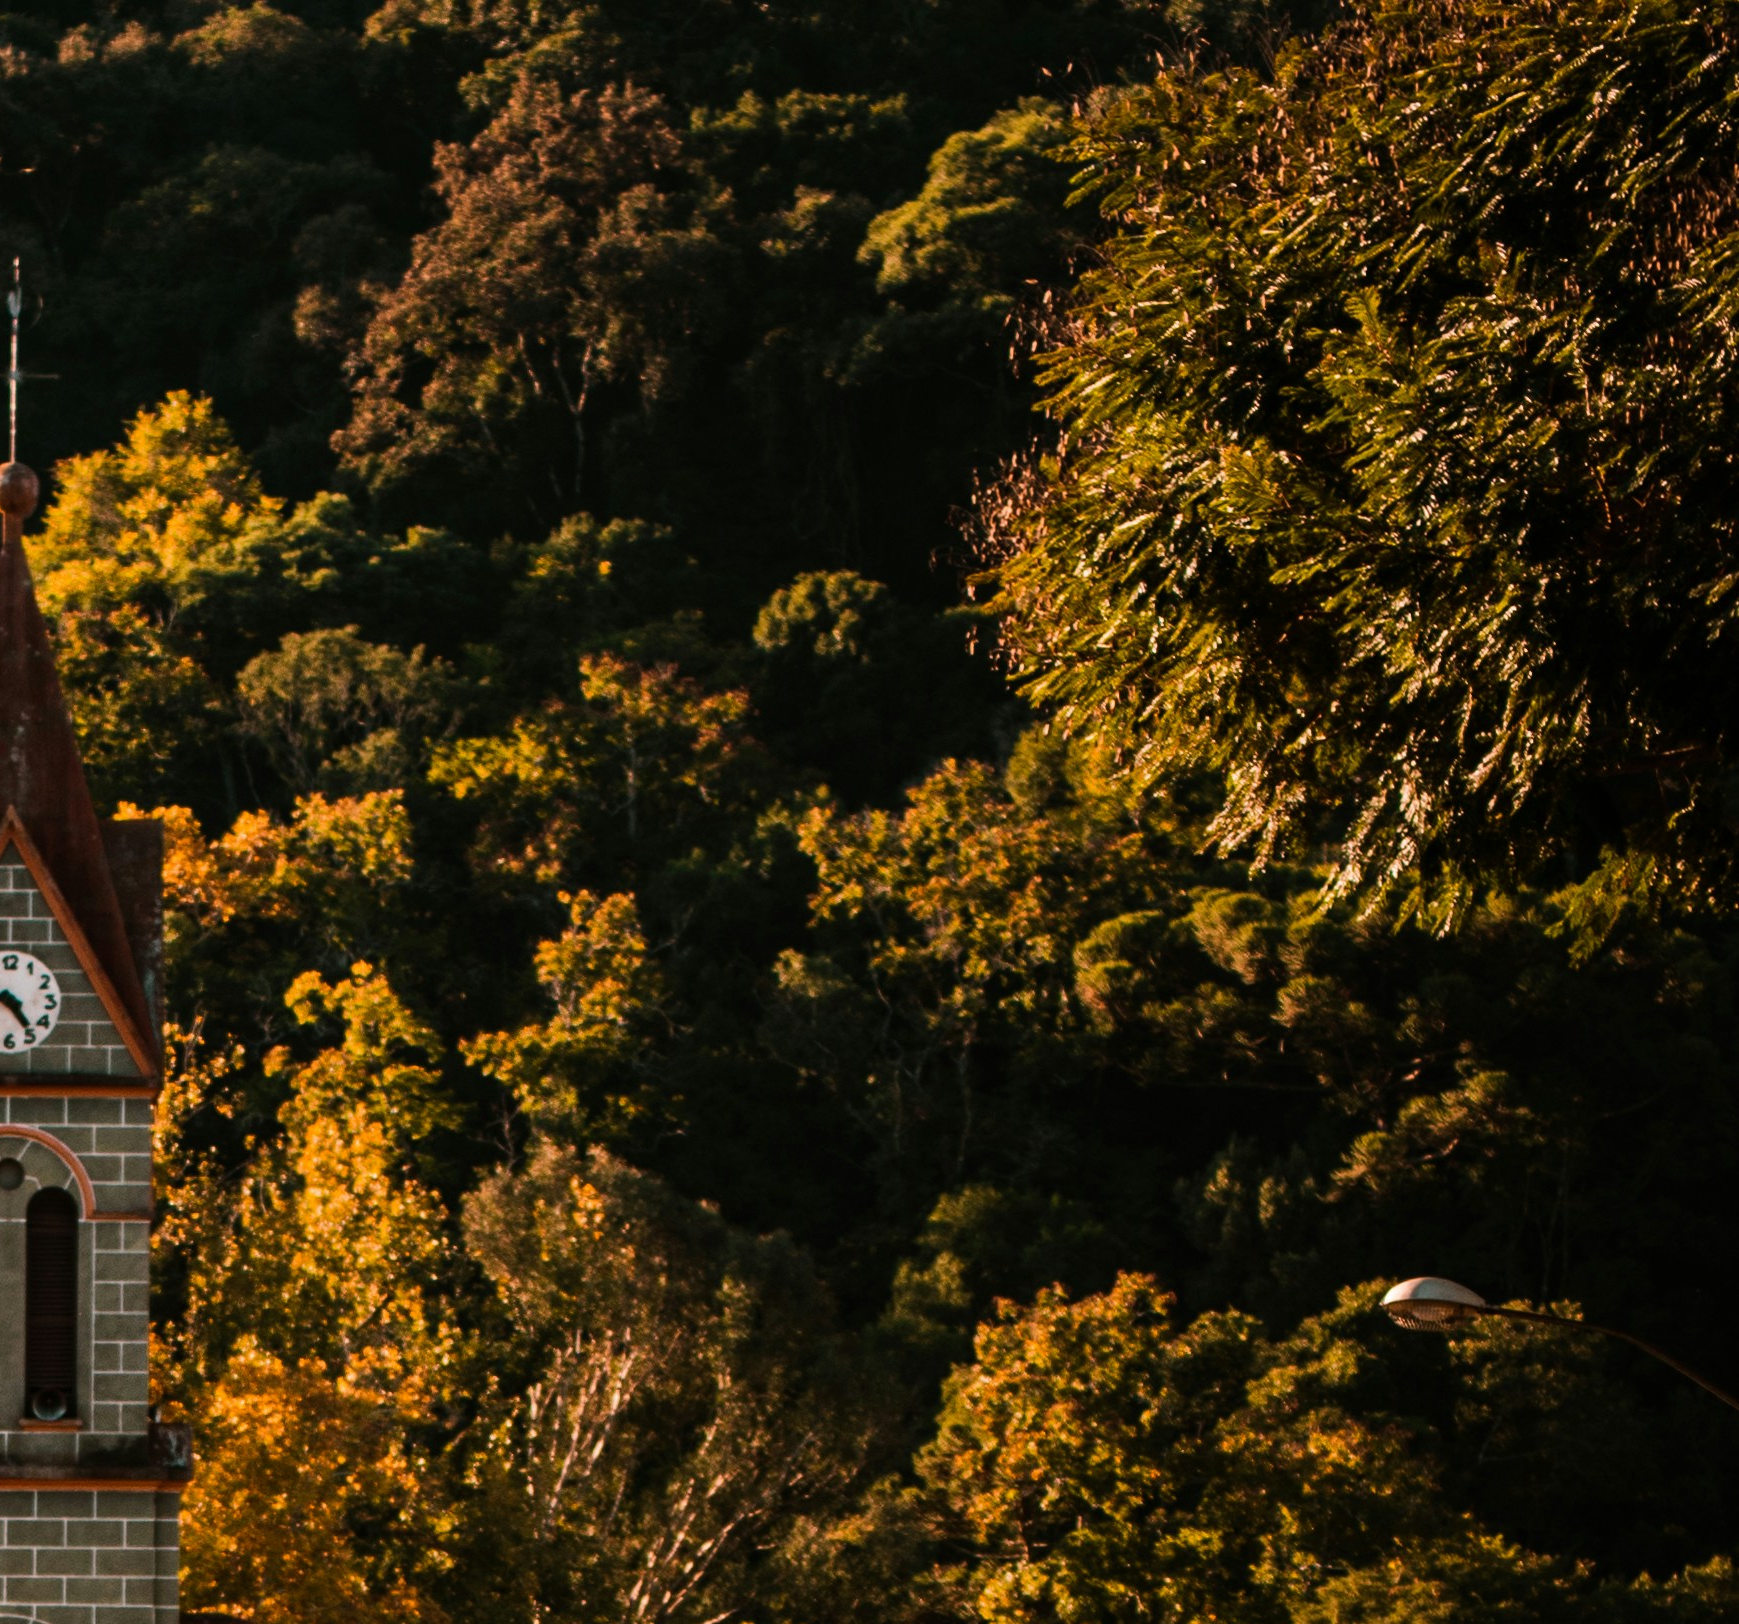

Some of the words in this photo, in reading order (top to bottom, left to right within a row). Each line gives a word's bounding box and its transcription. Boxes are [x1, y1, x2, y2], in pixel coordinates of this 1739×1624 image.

[2, 954, 19, 970] 12
[27, 961, 34, 975] 1
[40, 974, 50, 989] 2
[44, 994, 57, 1010] 3
[36, 1014, 50, 1029] 4
[4, 1033, 15, 1049] 6
[24, 1028, 36, 1044] 5
